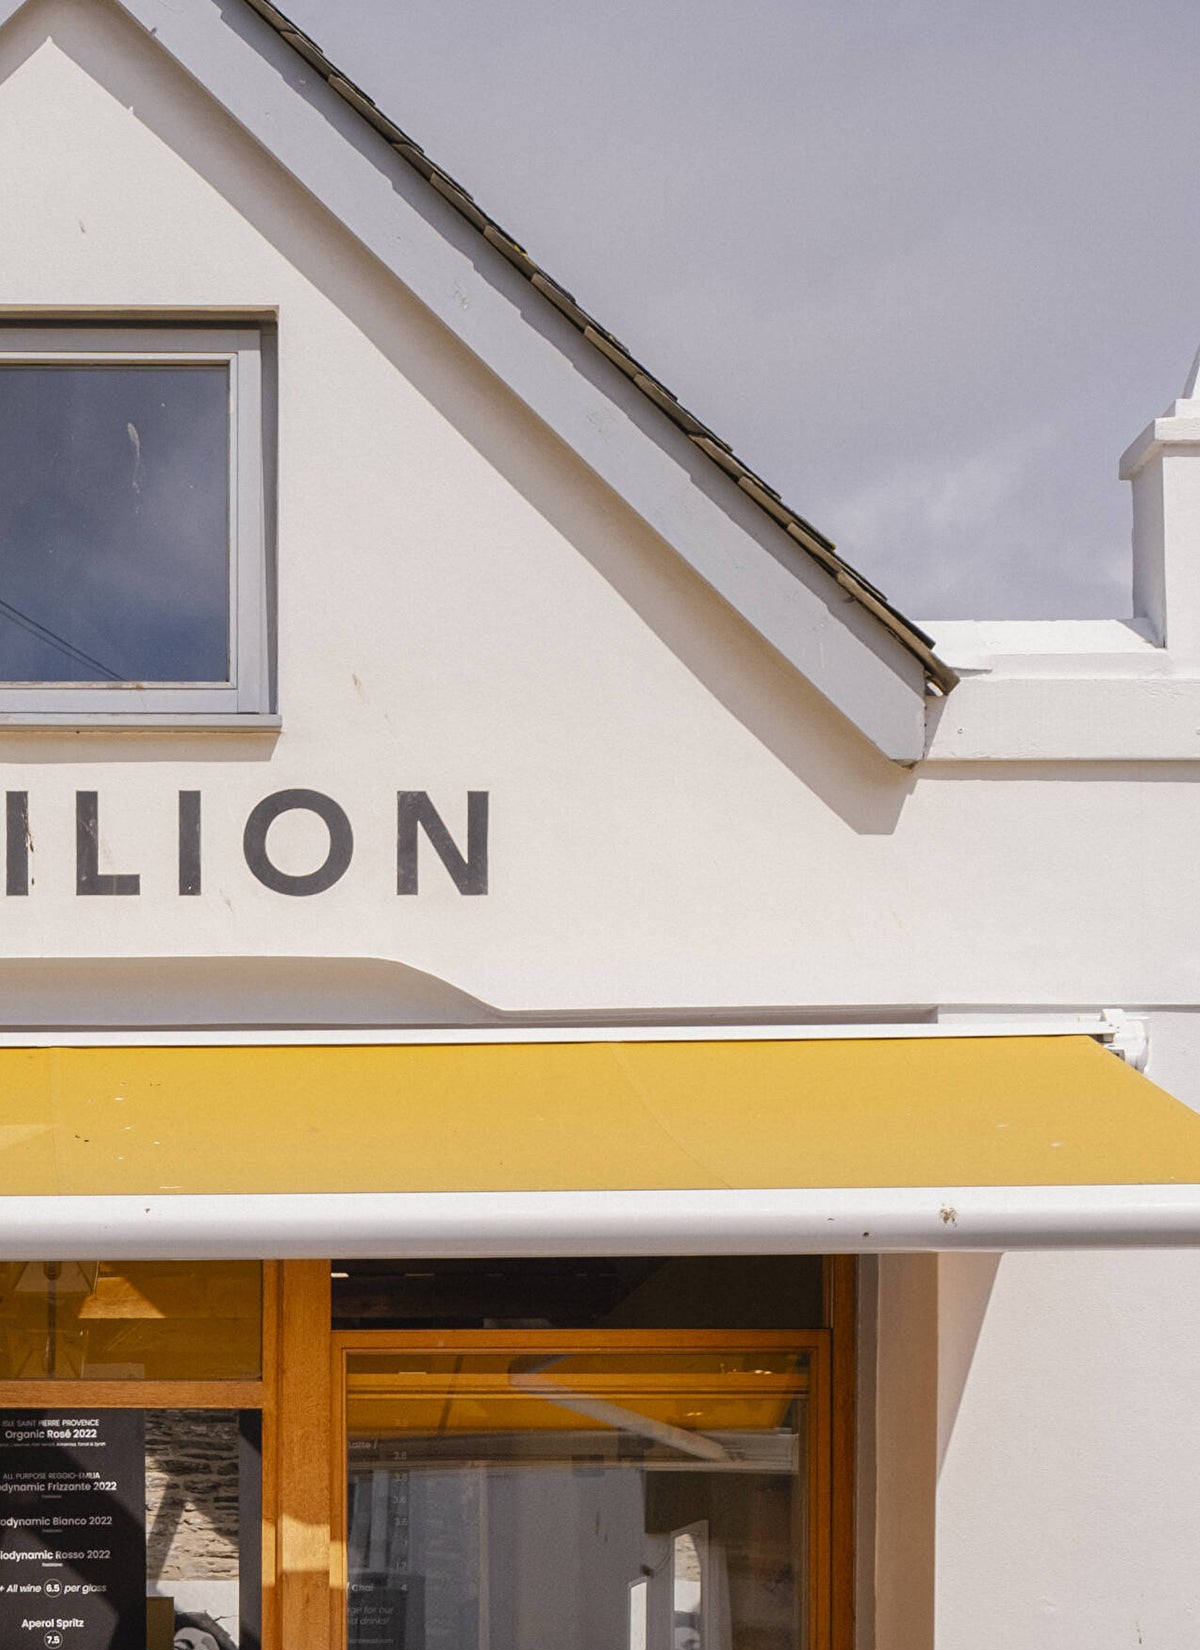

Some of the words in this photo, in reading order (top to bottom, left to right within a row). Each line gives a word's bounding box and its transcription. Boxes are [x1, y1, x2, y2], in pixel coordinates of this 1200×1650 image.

[62, 1419, 100, 1427] PROVENCE
[5, 1430, 45, 1440] Organic
[47, 1429, 71, 1438] Rosé
[73, 1429, 97, 1438] 2022
[47, 1482, 91, 1491] Frizzante
[93, 1481, 117, 1491] 2022
[52, 1517, 87, 1526] Bianco
[89, 1516, 112, 1525] 2022
[55, 1551, 85, 1559] Rosso
[87, 1550, 110, 1559] 2022
[6, 1584, 18, 1592] All
[19, 1583, 42, 1593] wine
[64, 1584, 81, 1594] per
[82, 1583, 107, 1595] glass
[21, 1619, 55, 1630] Aperol
[56, 1618, 85, 1630] Spritz
[46, 1636, 60, 1644] 7.5
